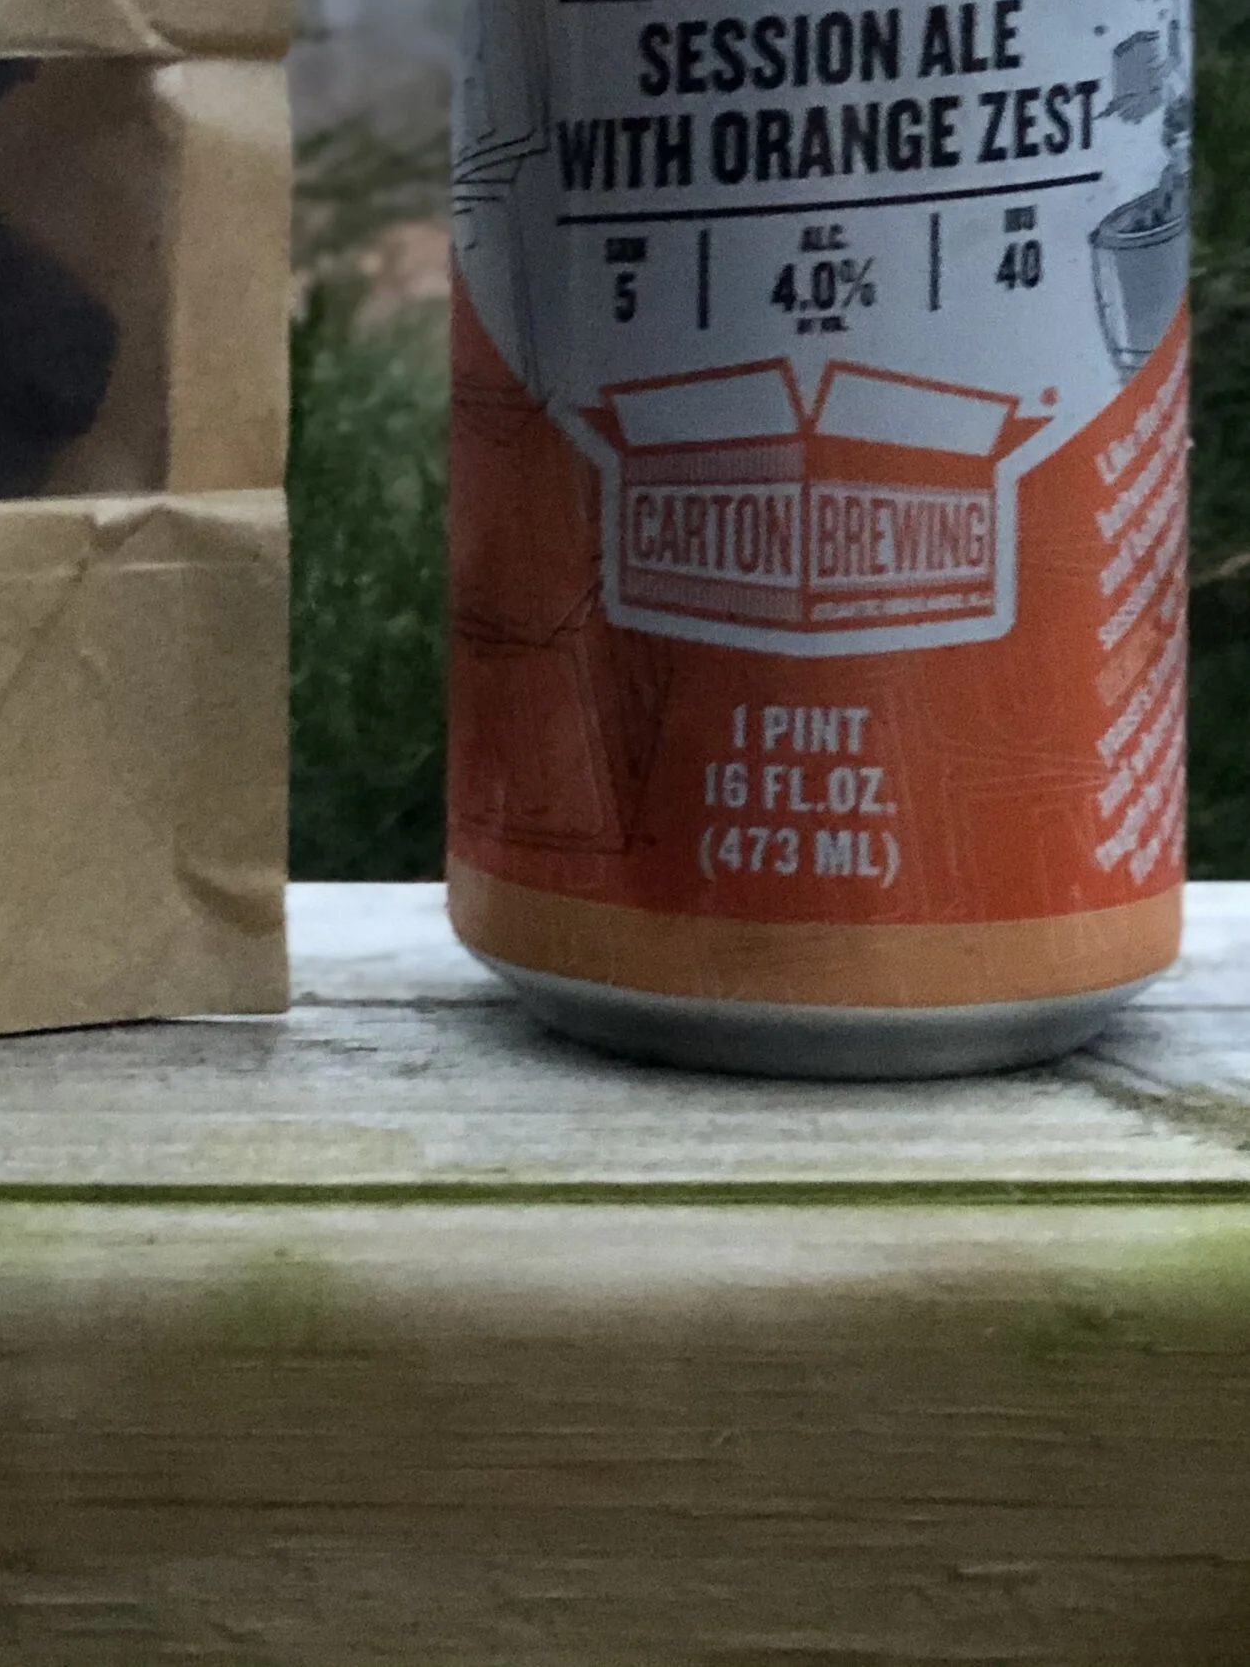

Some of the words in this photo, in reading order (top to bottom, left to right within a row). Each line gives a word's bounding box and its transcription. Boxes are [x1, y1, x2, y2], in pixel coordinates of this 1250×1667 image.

[638, 6, 901, 98] SESSION
[556, 114, 694, 192] WITH
[710, 95, 962, 187] ORANGE
[977, 78, 1102, 164] ZEST
[770, 256, 877, 313] 4.0%
[995, 239, 1043, 291] 40
[614, 270, 639, 324] 5
[634, 493, 794, 577] CARTON
[816, 493, 987, 579] BREWING
[762, 705, 872, 755] PINT
[704, 762, 749, 809] 16
[699, 825, 799, 883] (473
[813, 828, 900, 890] ML)
